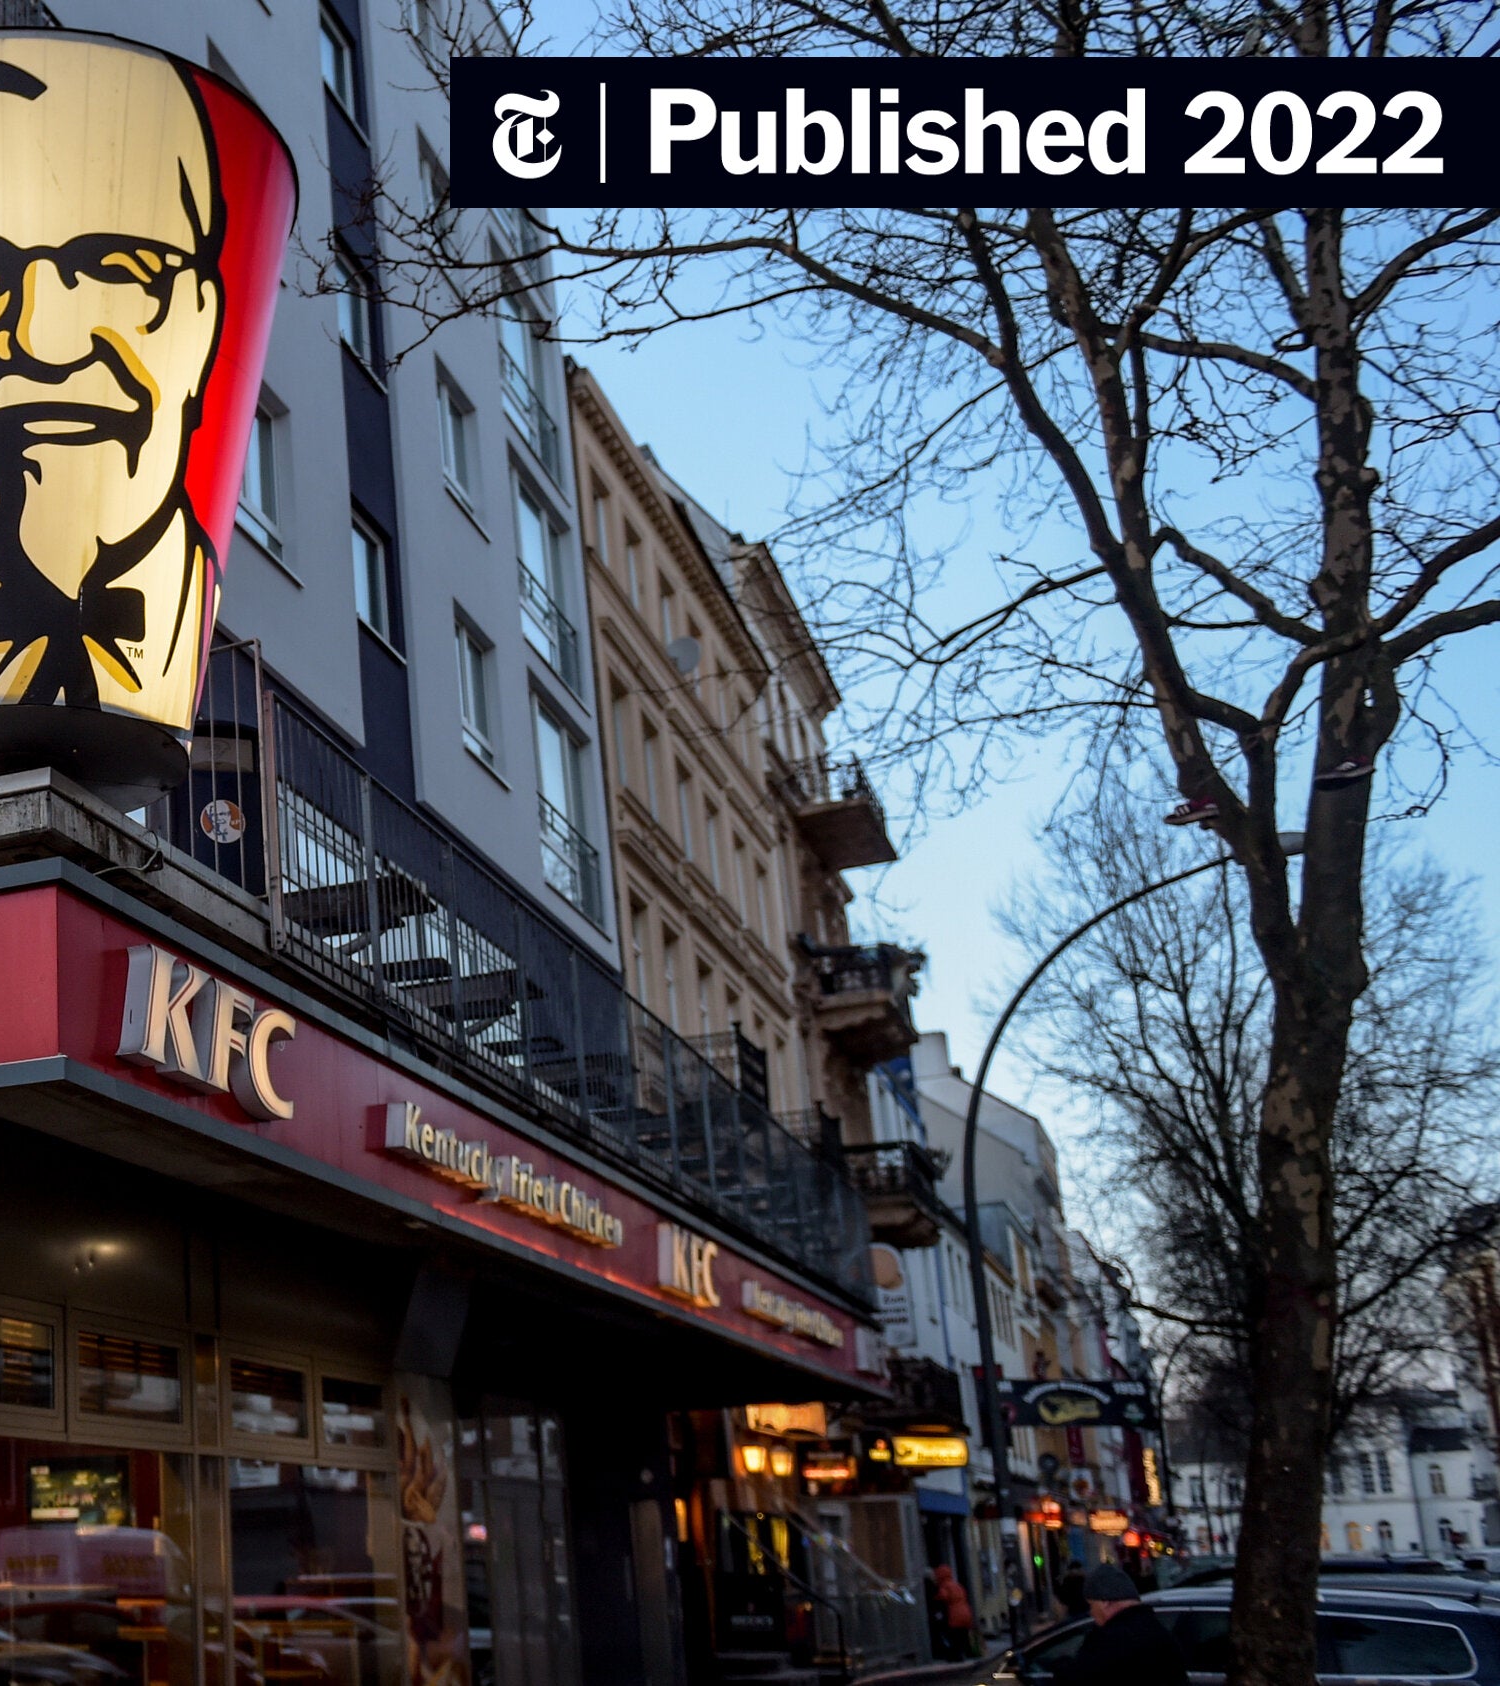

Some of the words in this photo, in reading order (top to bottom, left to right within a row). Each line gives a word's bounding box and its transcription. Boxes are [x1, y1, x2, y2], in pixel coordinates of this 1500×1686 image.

[126, 646, 144, 659] TM
[138, 944, 297, 1120] KFC
[405, 1101, 504, 1202] Kentucky
[511, 1155, 556, 1215] Fried
[560, 1182, 623, 1247] Chicken
[670, 1224, 721, 1308] KFC
